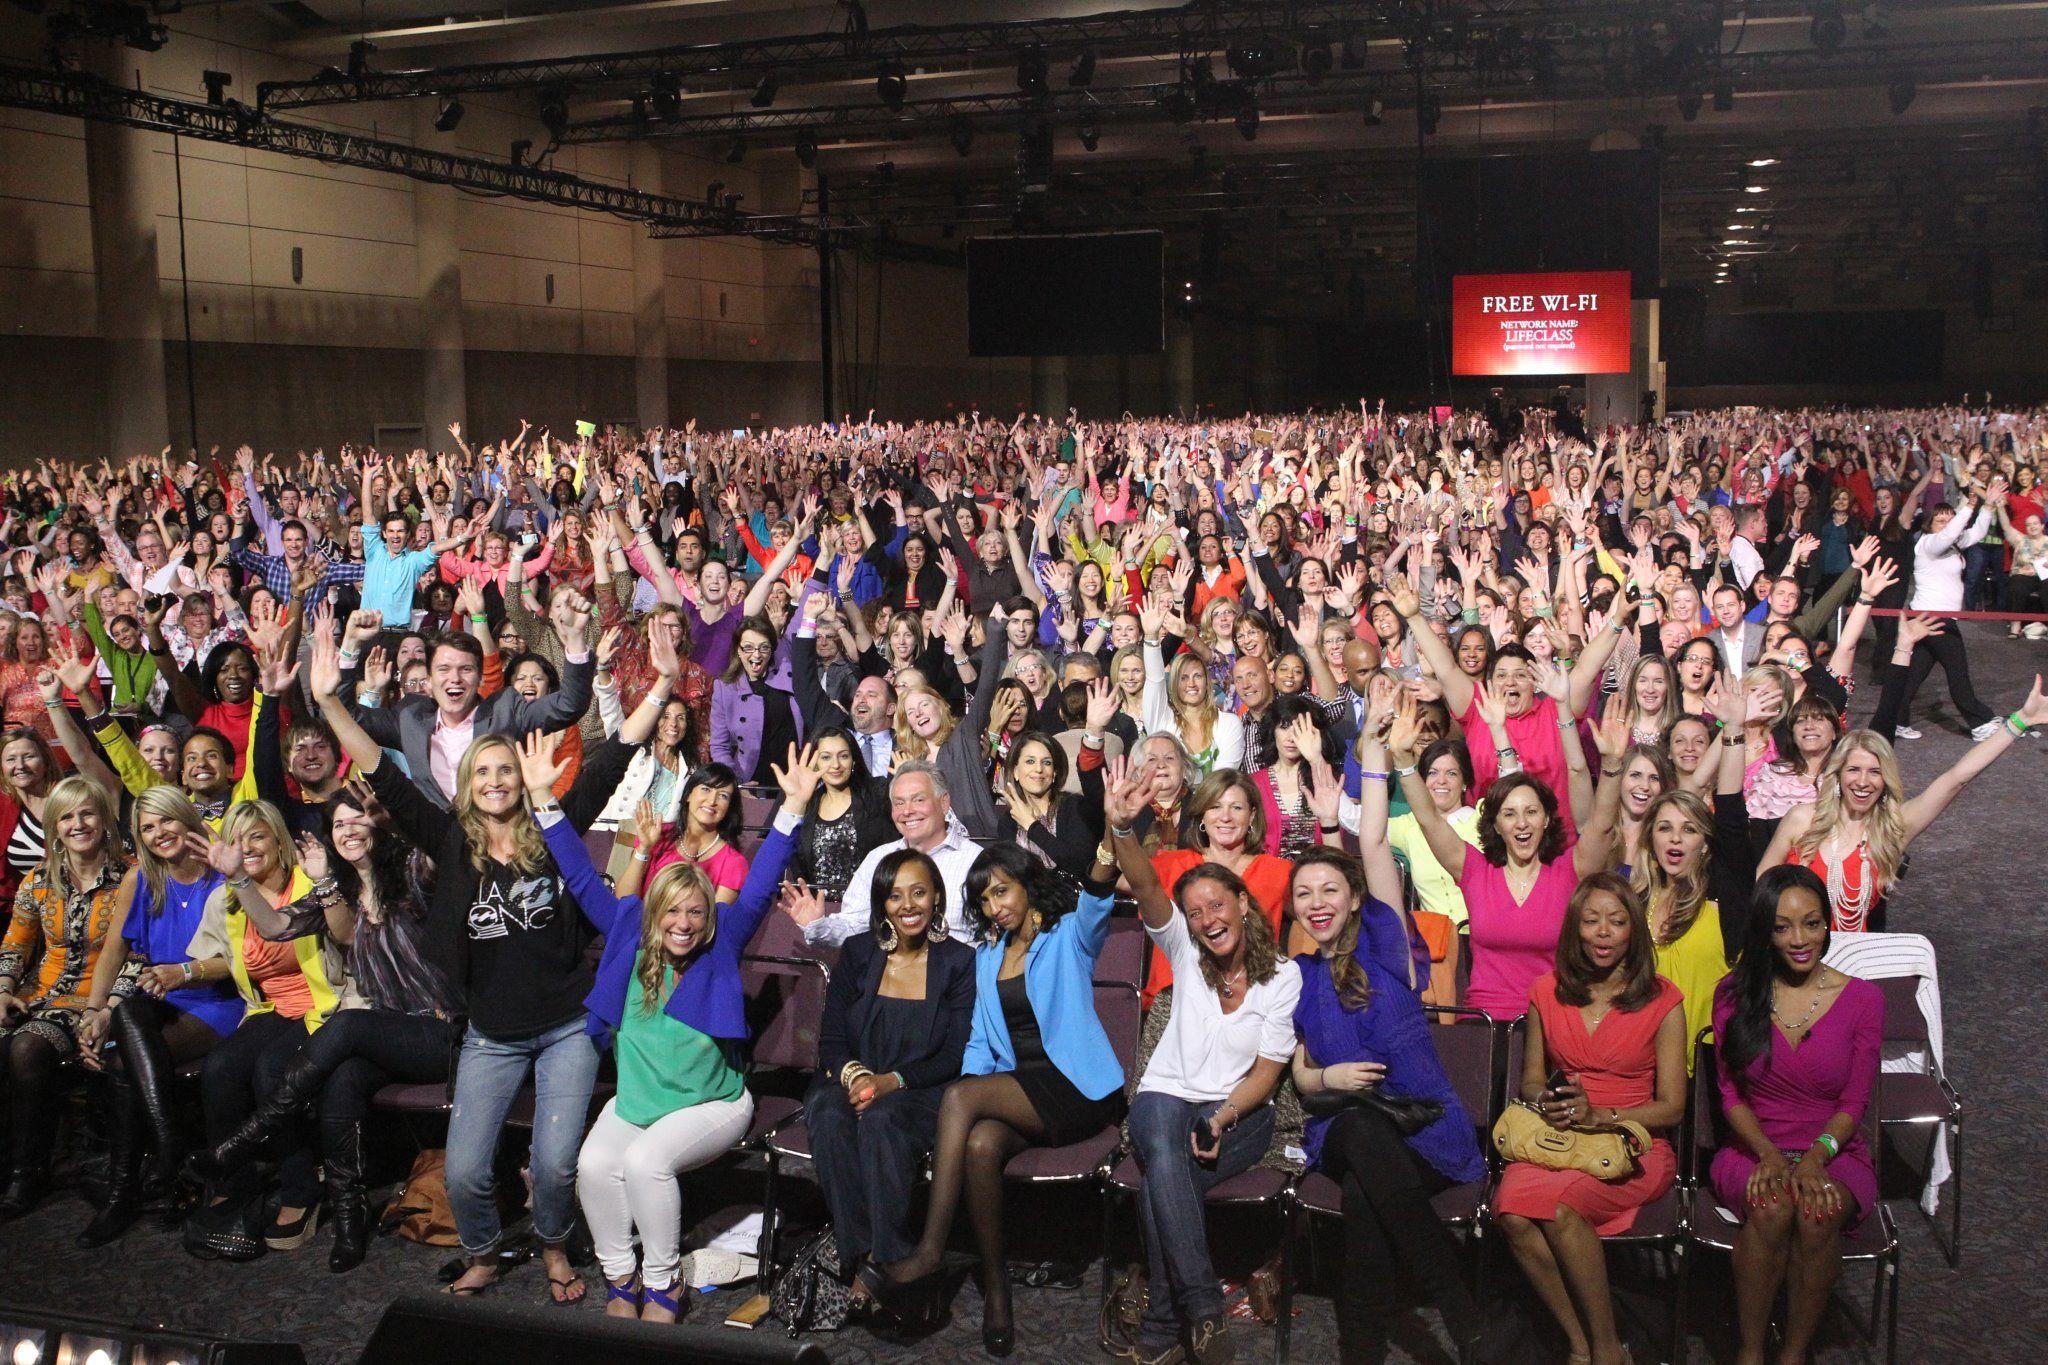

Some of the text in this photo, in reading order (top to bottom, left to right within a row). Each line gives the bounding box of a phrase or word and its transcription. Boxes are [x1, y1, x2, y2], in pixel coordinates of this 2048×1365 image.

[1482, 294, 1598, 313] FREE WI-FI
[1500, 319, 1579, 329] NETWORK NAME:
[1505, 329, 1574, 342] LIFECLASS
[1543, 1131, 1569, 1141] GUESS
